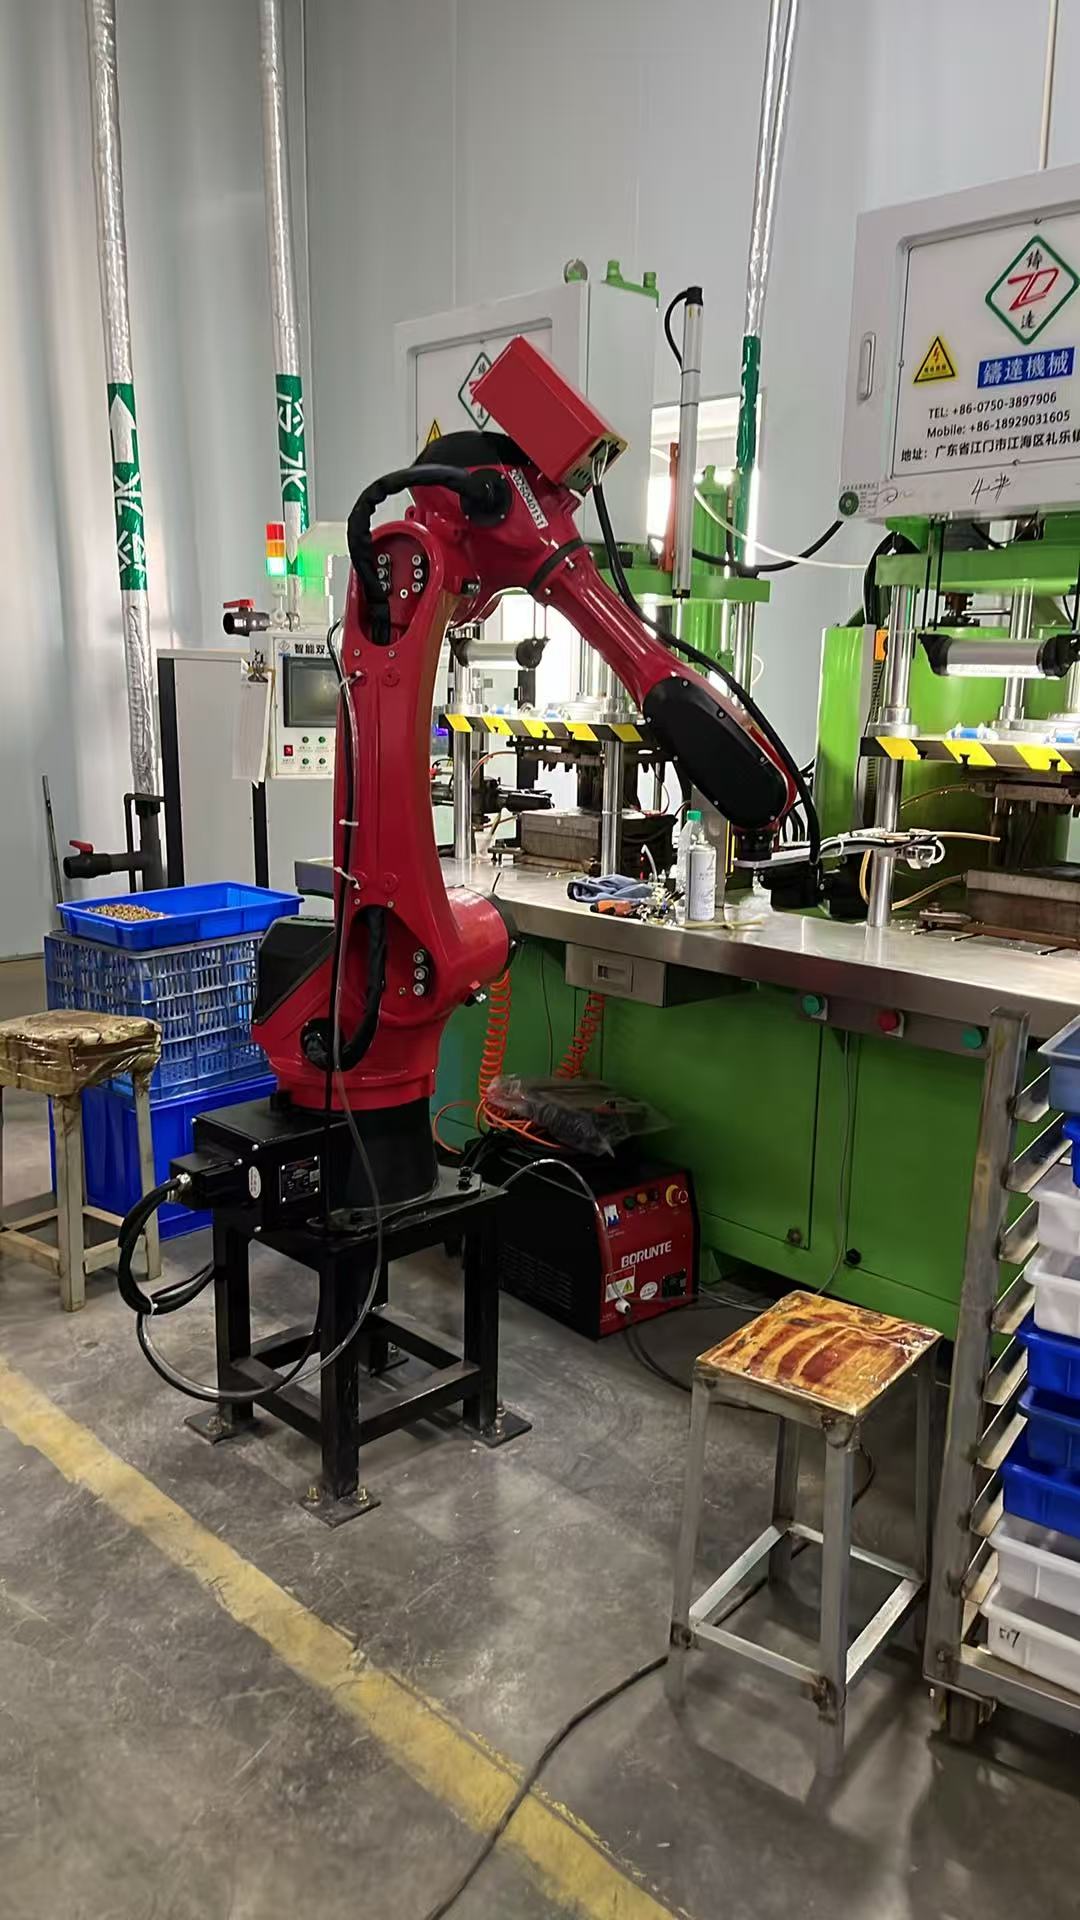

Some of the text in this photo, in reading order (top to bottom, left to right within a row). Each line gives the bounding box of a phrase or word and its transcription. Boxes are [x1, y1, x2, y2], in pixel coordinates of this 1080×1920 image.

[929, 392, 1057, 419] TEL: +86-0750-3897906
[927, 410, 1070, 438] Mobile: +86-18929031605
[276, 392, 306, 493] 冷水
[294, 643, 331, 655] 智能双
[620, 1240, 673, 1268] BORUNTE
